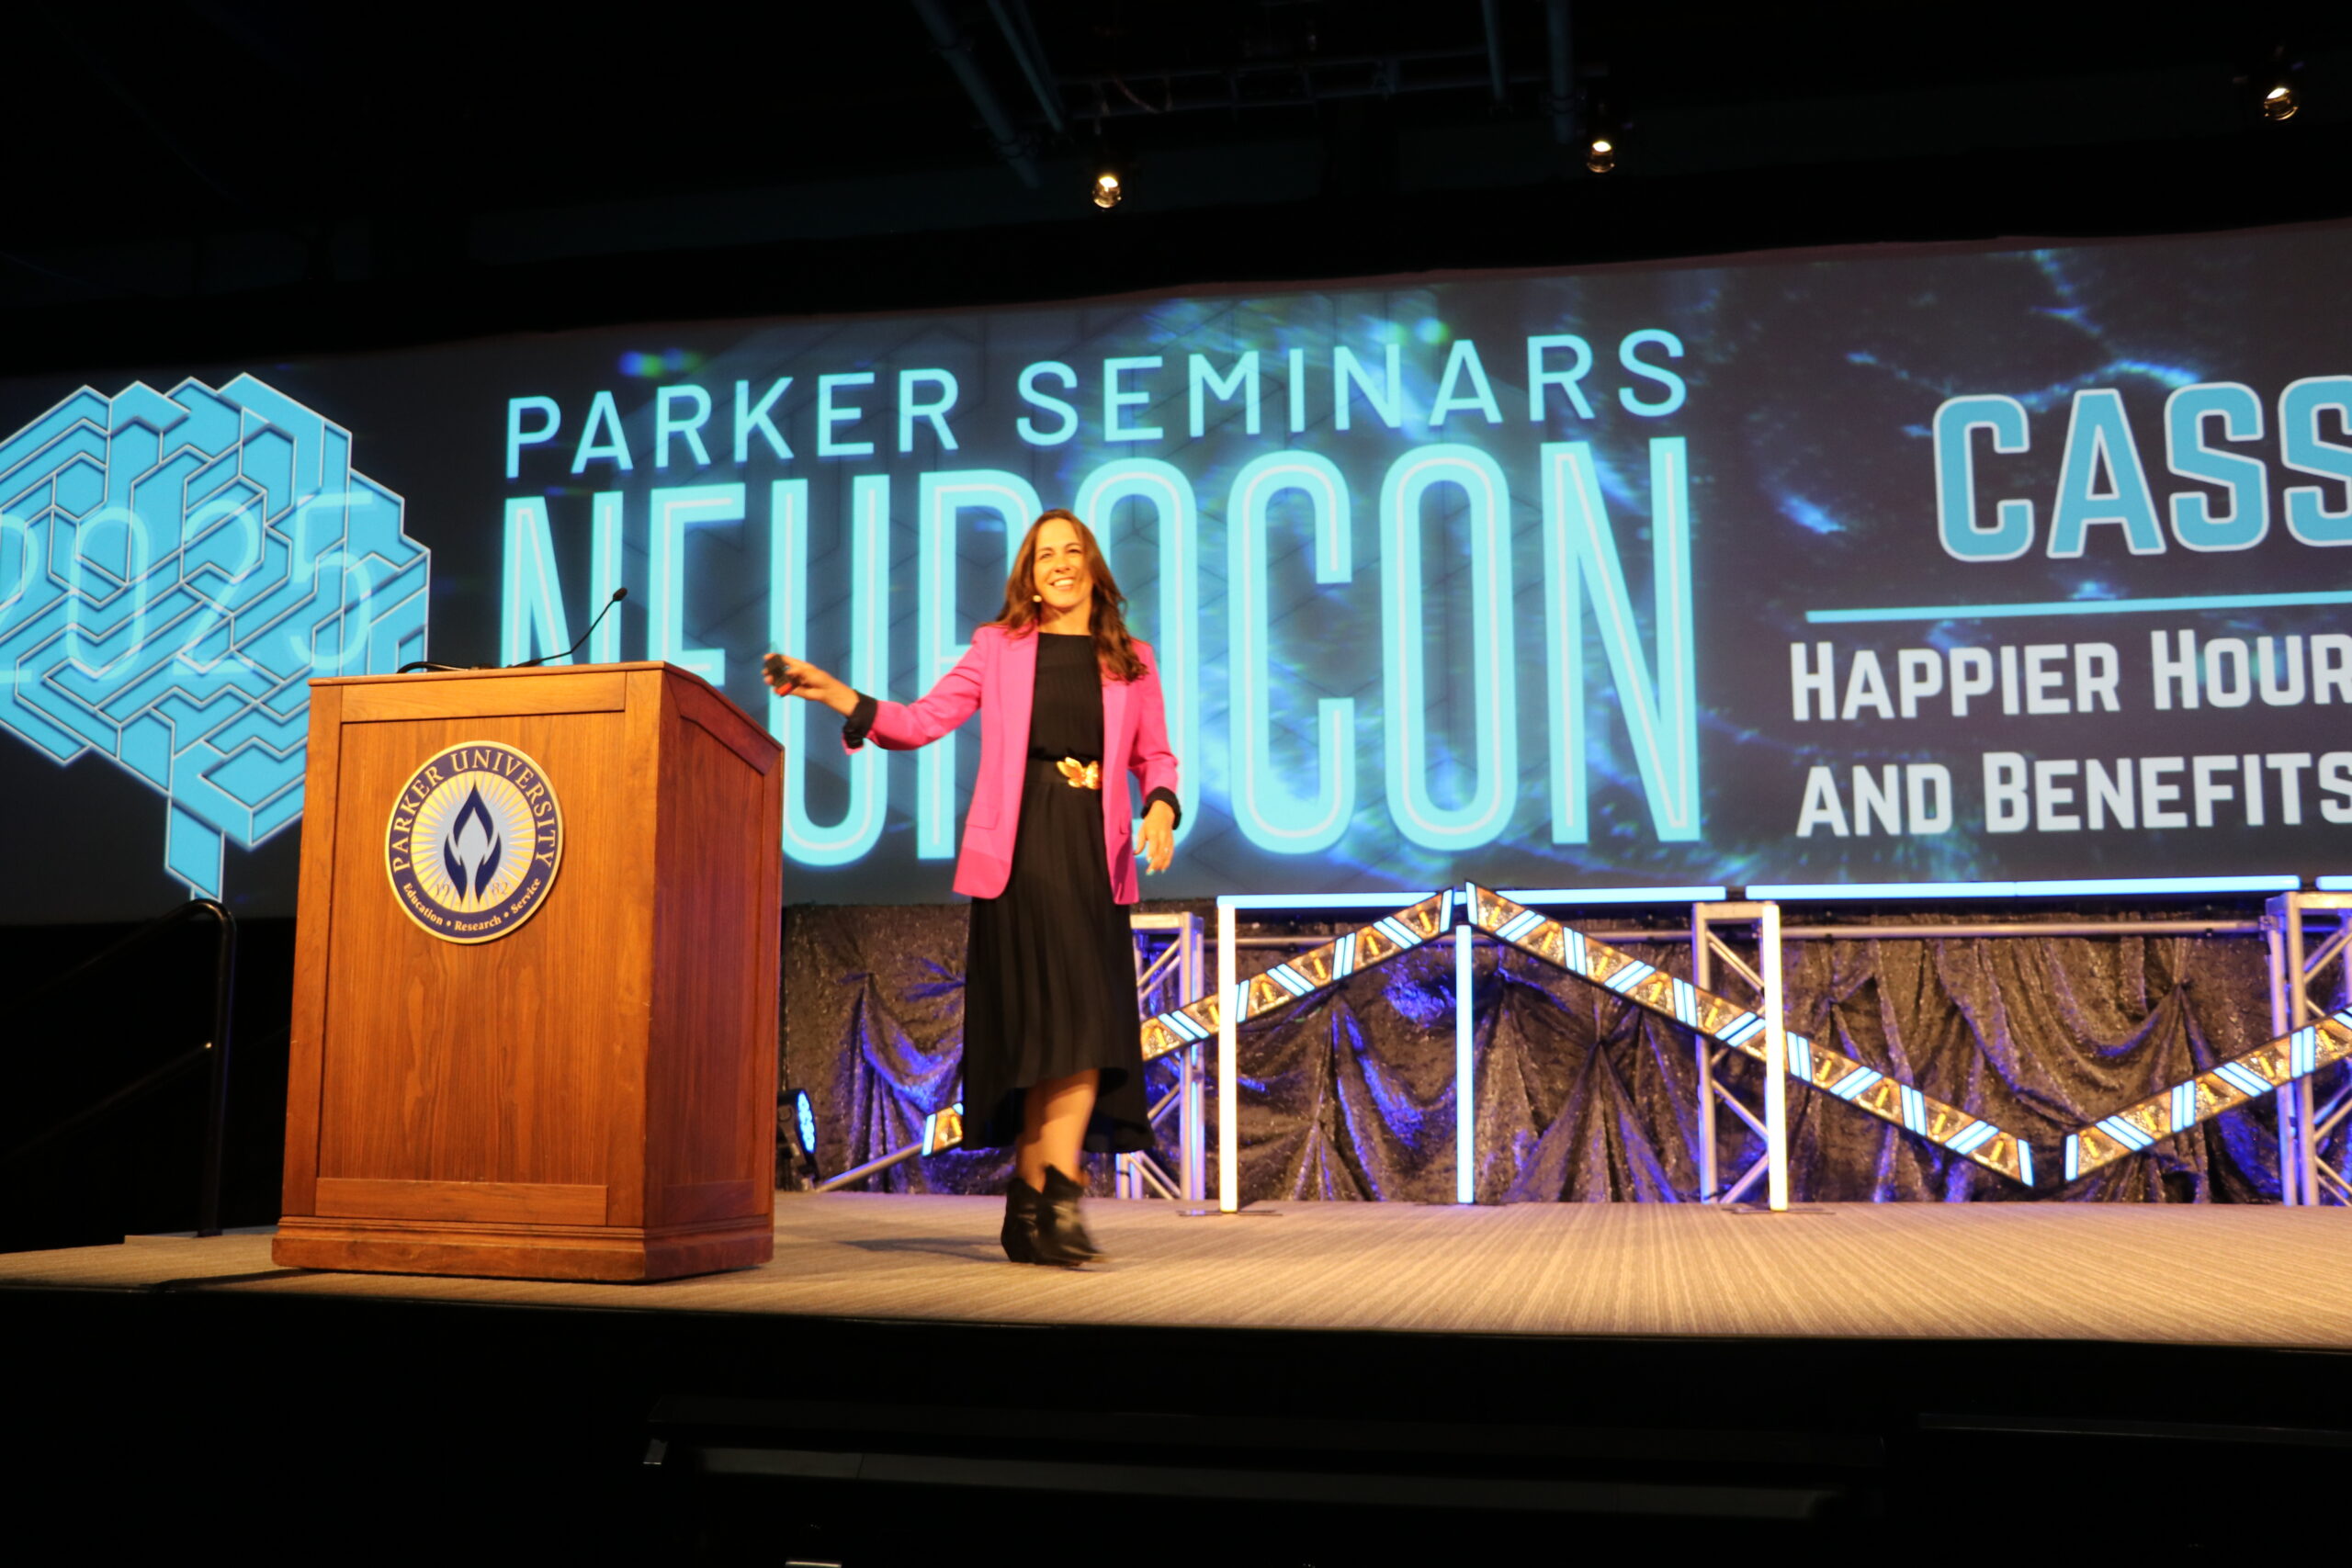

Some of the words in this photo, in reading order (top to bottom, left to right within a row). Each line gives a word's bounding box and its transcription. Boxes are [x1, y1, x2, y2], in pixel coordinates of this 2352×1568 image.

[505, 367, 959, 479] PARKER
[1016, 328, 1687, 447] SEMINARS
[1933, 374, 2352, 562] CASS
[1790, 641, 2121, 722] HAPPIER
[2151, 628, 2352, 711] HOUR
[391, 765, 444, 873] PARKER
[450, 749, 556, 868] UNIVERSITY
[1795, 762, 1954, 838] AND
[1983, 750, 2352, 833] BENEFITS
[403, 883, 443, 926] Education
[454, 915, 503, 931] Research
[511, 877, 542, 915] Service
